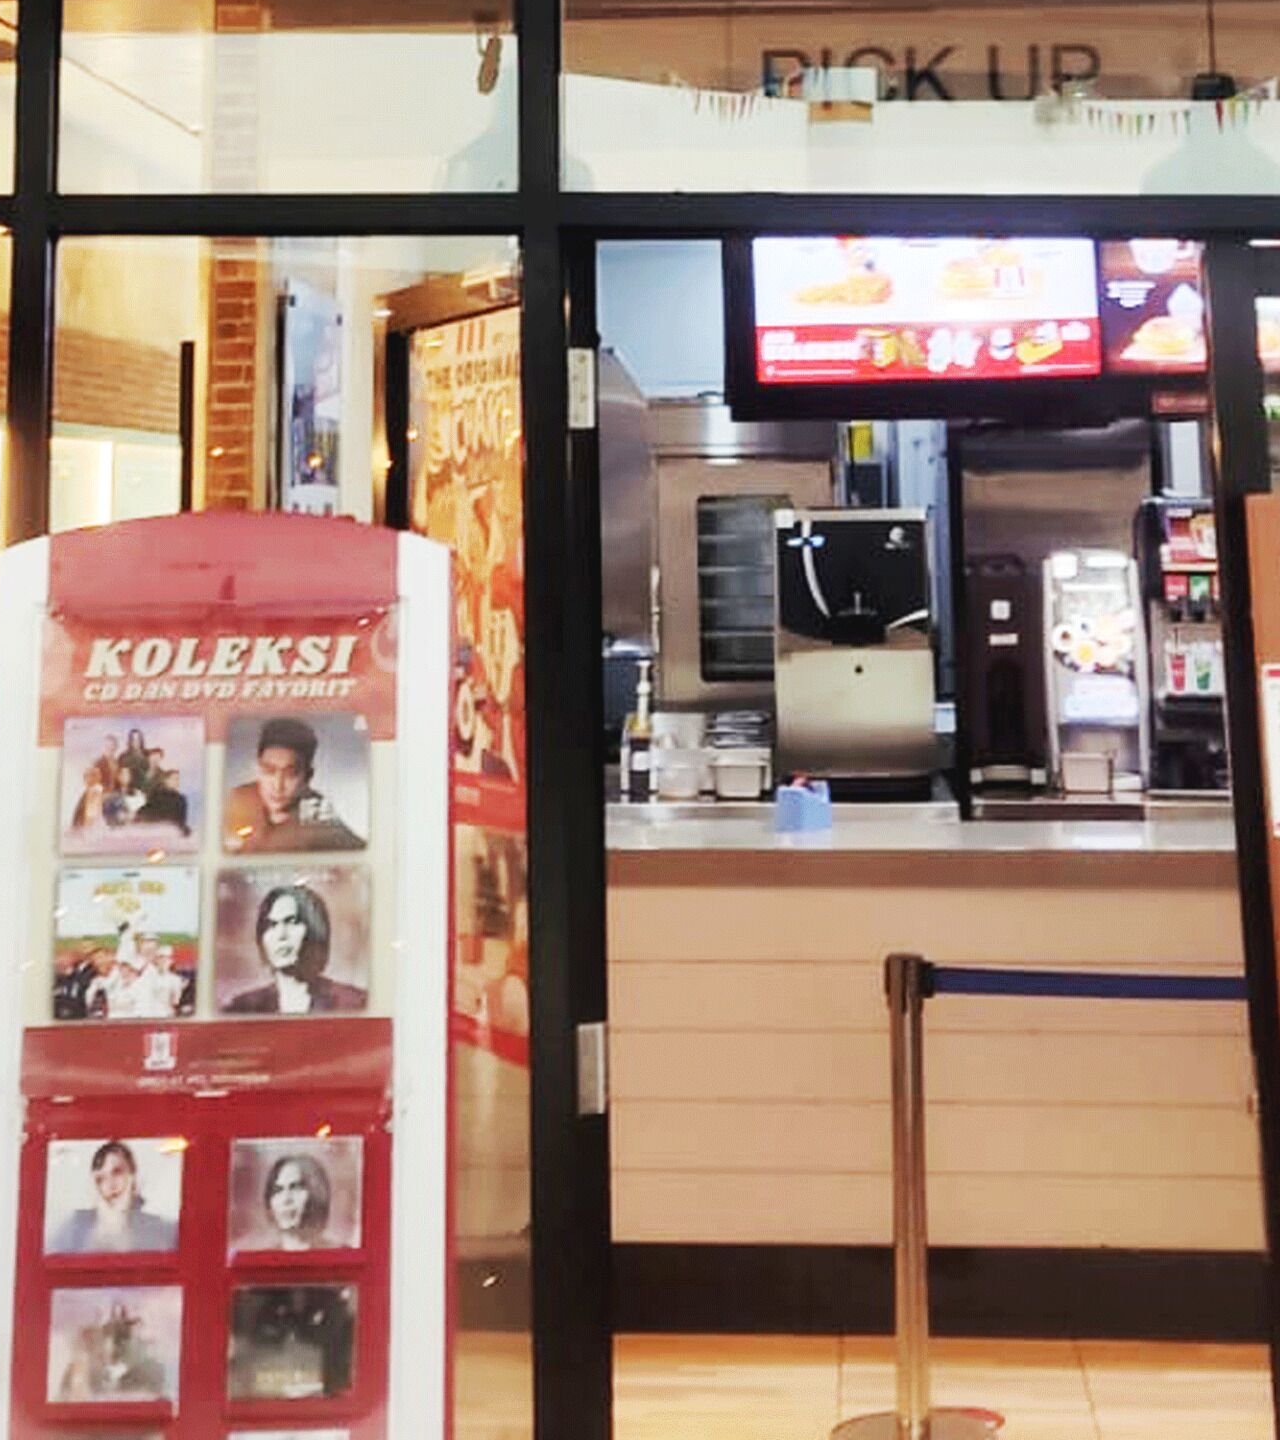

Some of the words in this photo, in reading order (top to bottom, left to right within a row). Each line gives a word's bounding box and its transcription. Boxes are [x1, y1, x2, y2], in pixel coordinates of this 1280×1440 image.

[987, 42, 1102, 101] UP
[83, 633, 360, 679] KOLEKSI
[83, 681, 120, 702] CD
[179, 680, 237, 700] DVD
[241, 677, 358, 699] FAVORIT
